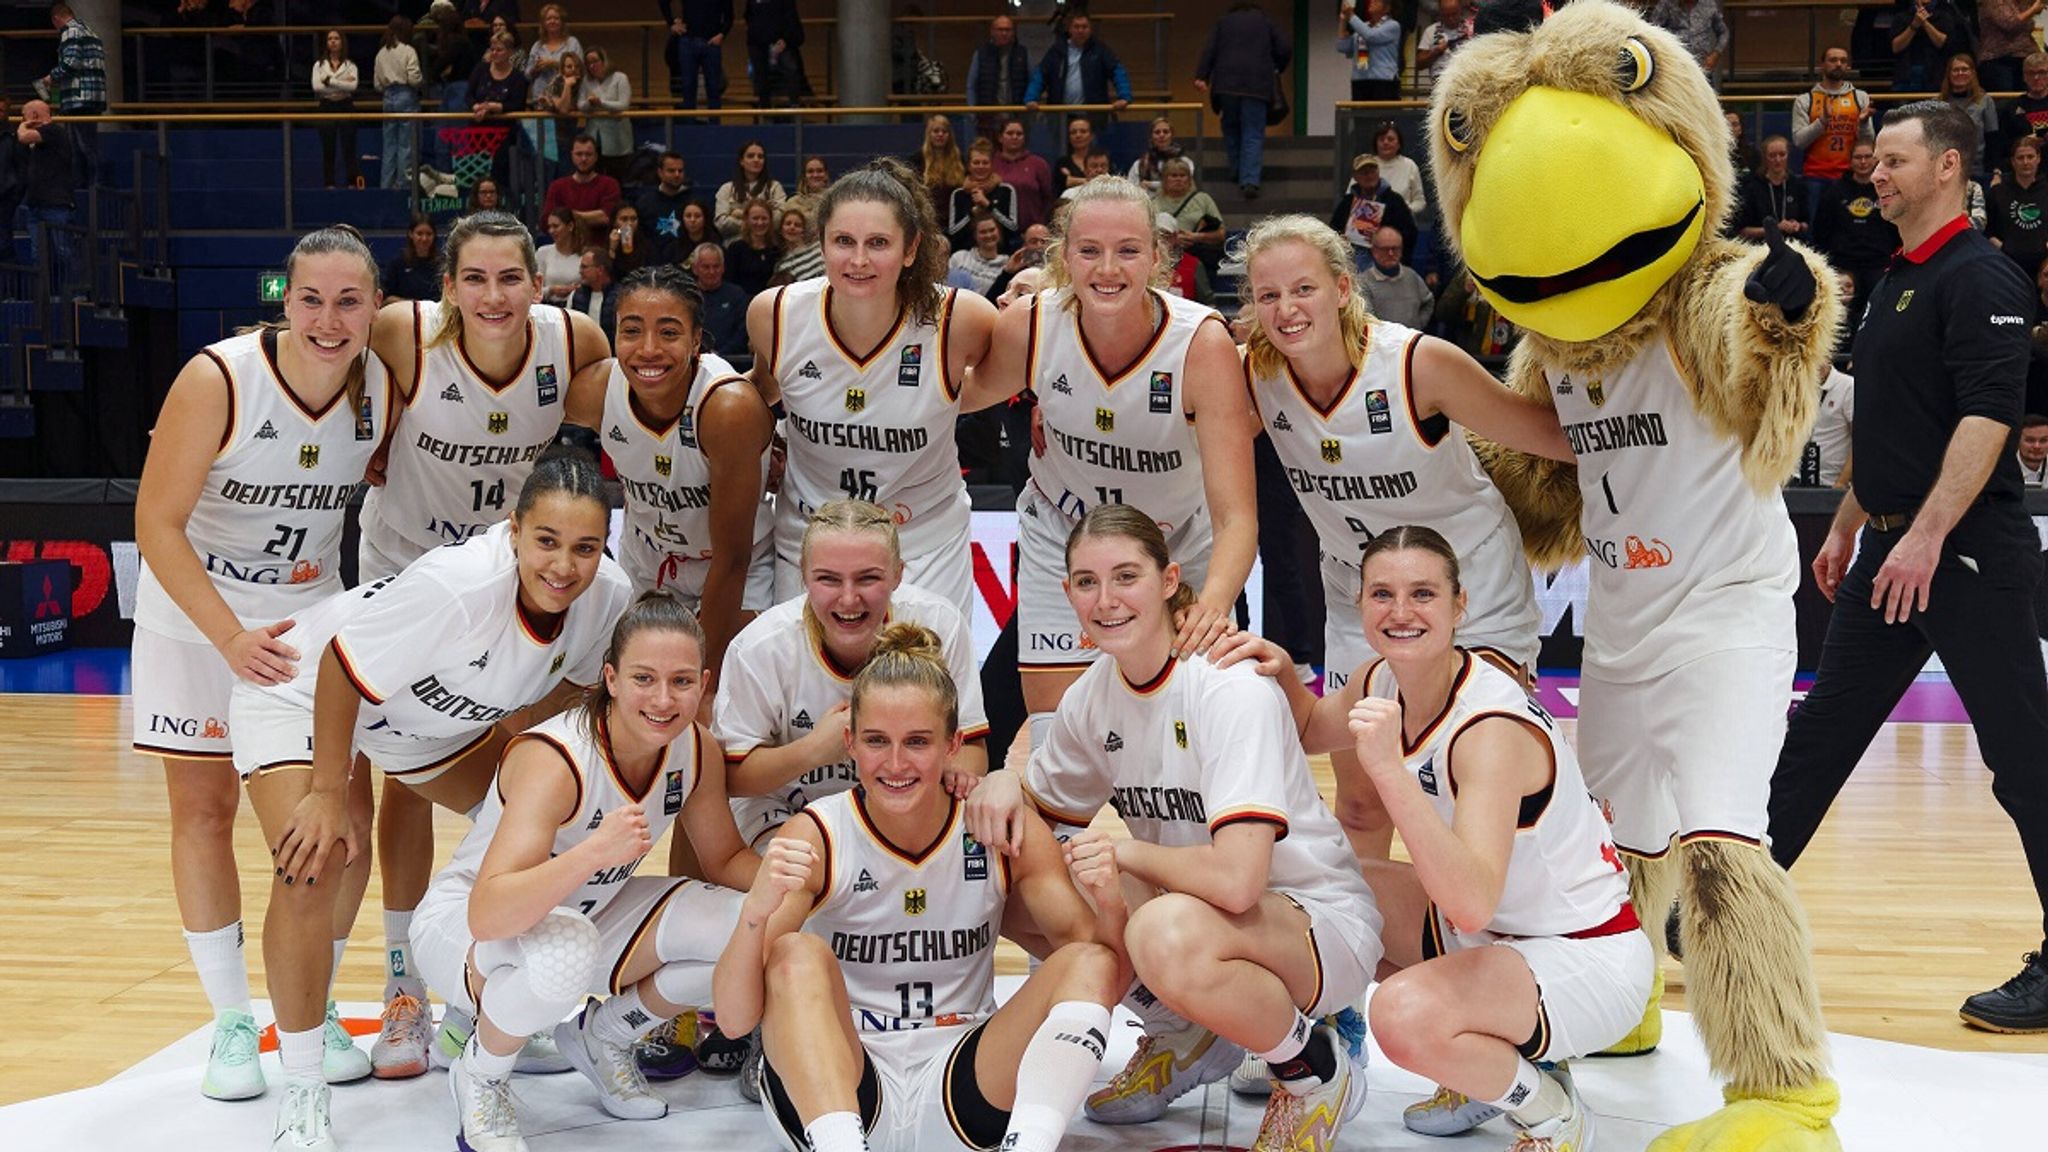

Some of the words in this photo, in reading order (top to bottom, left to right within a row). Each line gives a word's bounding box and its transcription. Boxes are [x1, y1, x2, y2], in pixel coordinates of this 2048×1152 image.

[1829, 136, 1844, 151] 21
[1808, 447, 1817, 458] 3
[1808, 460, 1816, 471] 2
[1808, 474, 1816, 484] 1
[470, 478, 506, 512] 14
[1056, 487, 1086, 518] IN
[262, 523, 308, 562] 21
[1585, 537, 1618, 569] NG
[206, 551, 280, 584] ING
[30, 618, 68, 635] MITSUBISHI
[1031, 633, 1073, 651] ING
[1329, 671, 1348, 689] IN
[150, 714, 198, 737] ING
[831, 921, 990, 964] DEUTSCHLAND
[895, 981, 934, 1018] 13
